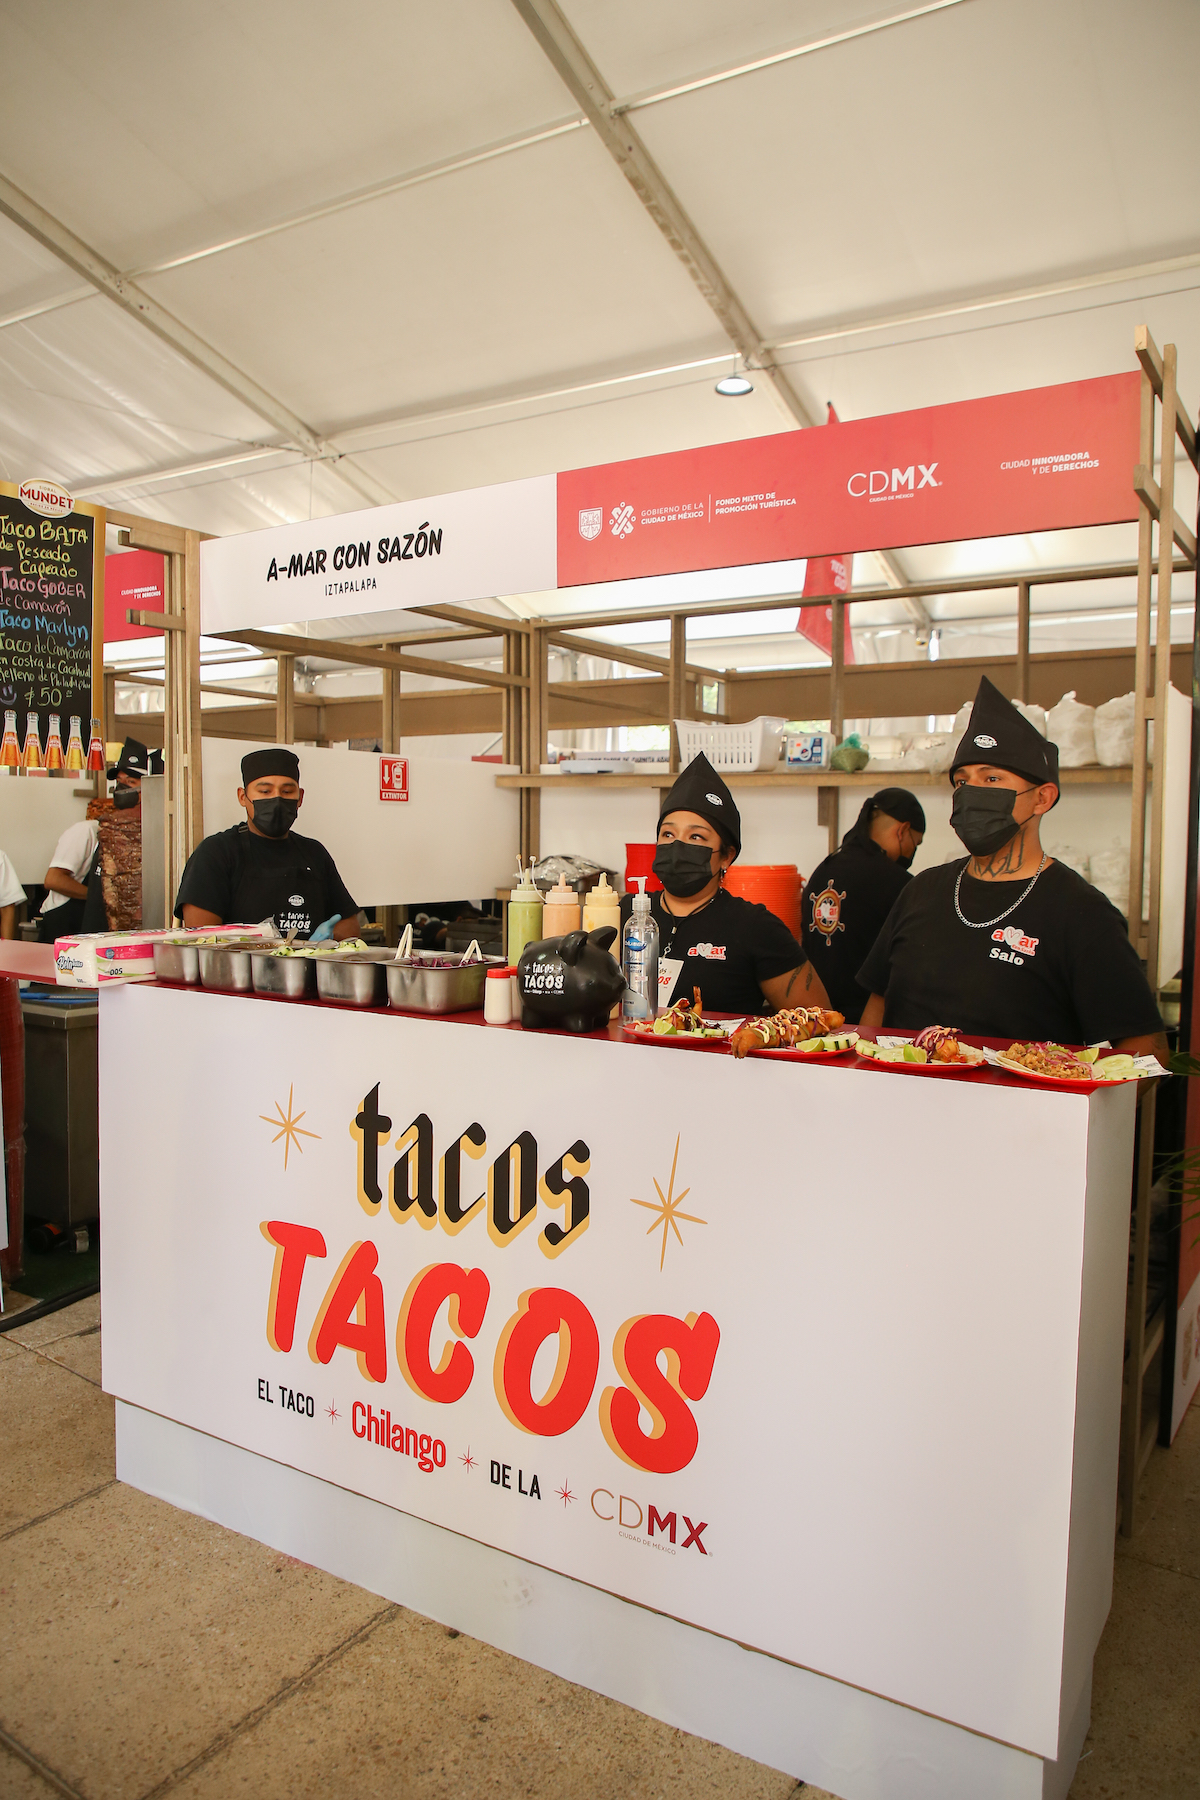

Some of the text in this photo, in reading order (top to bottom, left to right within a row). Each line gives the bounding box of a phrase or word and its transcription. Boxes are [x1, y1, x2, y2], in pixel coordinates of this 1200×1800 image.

[1000, 451, 1090, 470] CIUDAD INNOVADORA
[1032, 459, 1099, 475] Y DE DERECHOS
[847, 462, 939, 497] CDMX
[20, 486, 74, 510] MUNDET
[715, 491, 776, 507] FONDO MIXTO DE
[715, 497, 797, 515] PROMOCIÓN TURÍSTICA
[641, 504, 680, 517] GOBIERNO
[682, 503, 692, 511] DE
[641, 510, 704, 525] CIUDAD DE MÉXICO
[0, 515, 88, 546] Taco BAJA
[0, 535, 71, 563] de Pescado
[267, 521, 443, 582] A-MAR CON SAZÓN
[20, 560, 78, 579] Capeado
[0, 566, 86, 599] Taco GOBER
[325, 577, 377, 596] IZTAPALAPA
[14, 594, 71, 616] Camarón
[0, 609, 89, 647] Taco Marlyn
[35, 634, 46, 654] de
[0, 656, 8, 665] n
[12, 655, 44, 669] costra
[46, 656, 56, 669] de
[38, 668, 48, 682] de
[382, 792, 407, 800] EXTINTOR
[280, 919, 311, 929] TACOS
[989, 947, 1024, 966] Salo
[532, 961, 555, 973] tacos
[524, 974, 564, 989] TACOS
[350, 1081, 591, 1259] tacos
[260, 1220, 720, 1474] TACOS
[258, 1378, 709, 1556] EL TACO Chilango DE LA CDMX
[618, 1530, 677, 1556] CIUDAD DE MÉXICO
